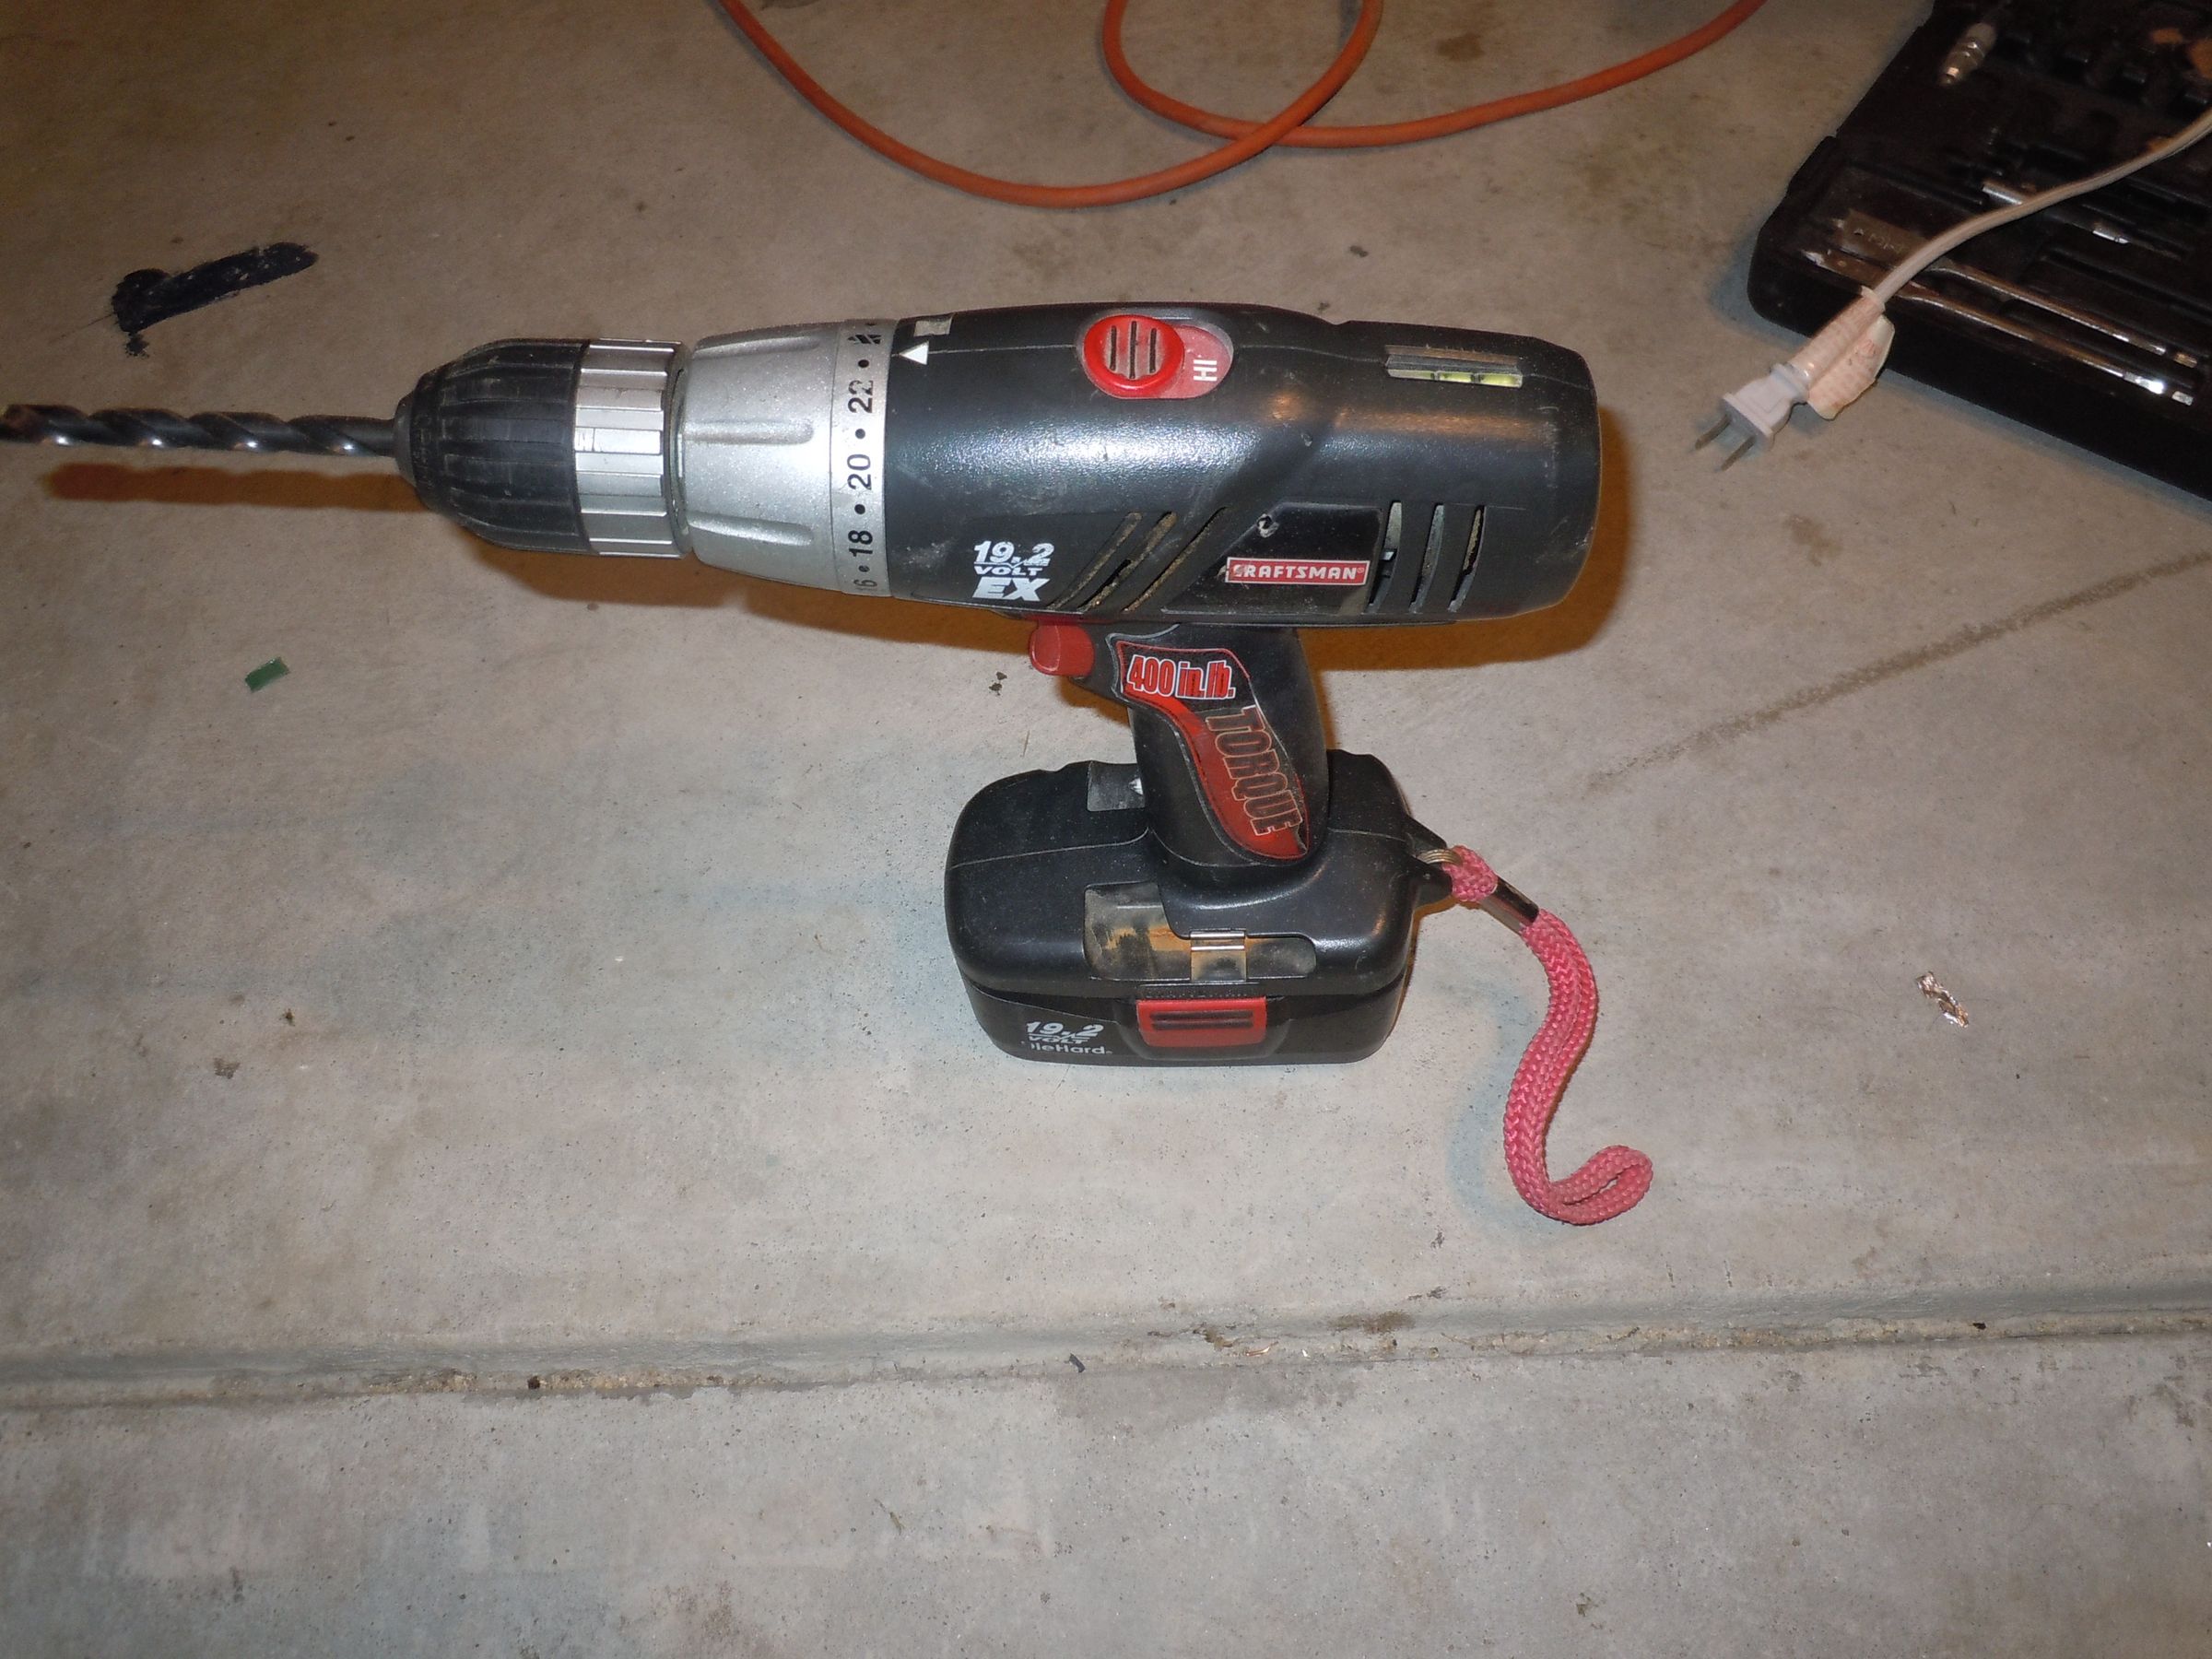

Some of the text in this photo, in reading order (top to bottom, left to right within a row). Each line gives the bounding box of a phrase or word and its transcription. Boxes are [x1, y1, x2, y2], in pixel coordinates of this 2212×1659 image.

[1193, 359, 1218, 382] HI
[848, 380, 874, 413] 22
[847, 453, 872, 490] 20
[848, 530, 873, 557] 18
[973, 540, 1054, 566] 19.2
[973, 566, 1043, 576] VOLT
[1233, 564, 1358, 580] CRAFTSMAN
[971, 576, 1051, 602] EX
[1127, 654, 1177, 697] 400
[1206, 704, 1303, 836] TORQUE
[1027, 1021, 1104, 1037] 19.2
[1029, 1035, 1088, 1044] VOLT
